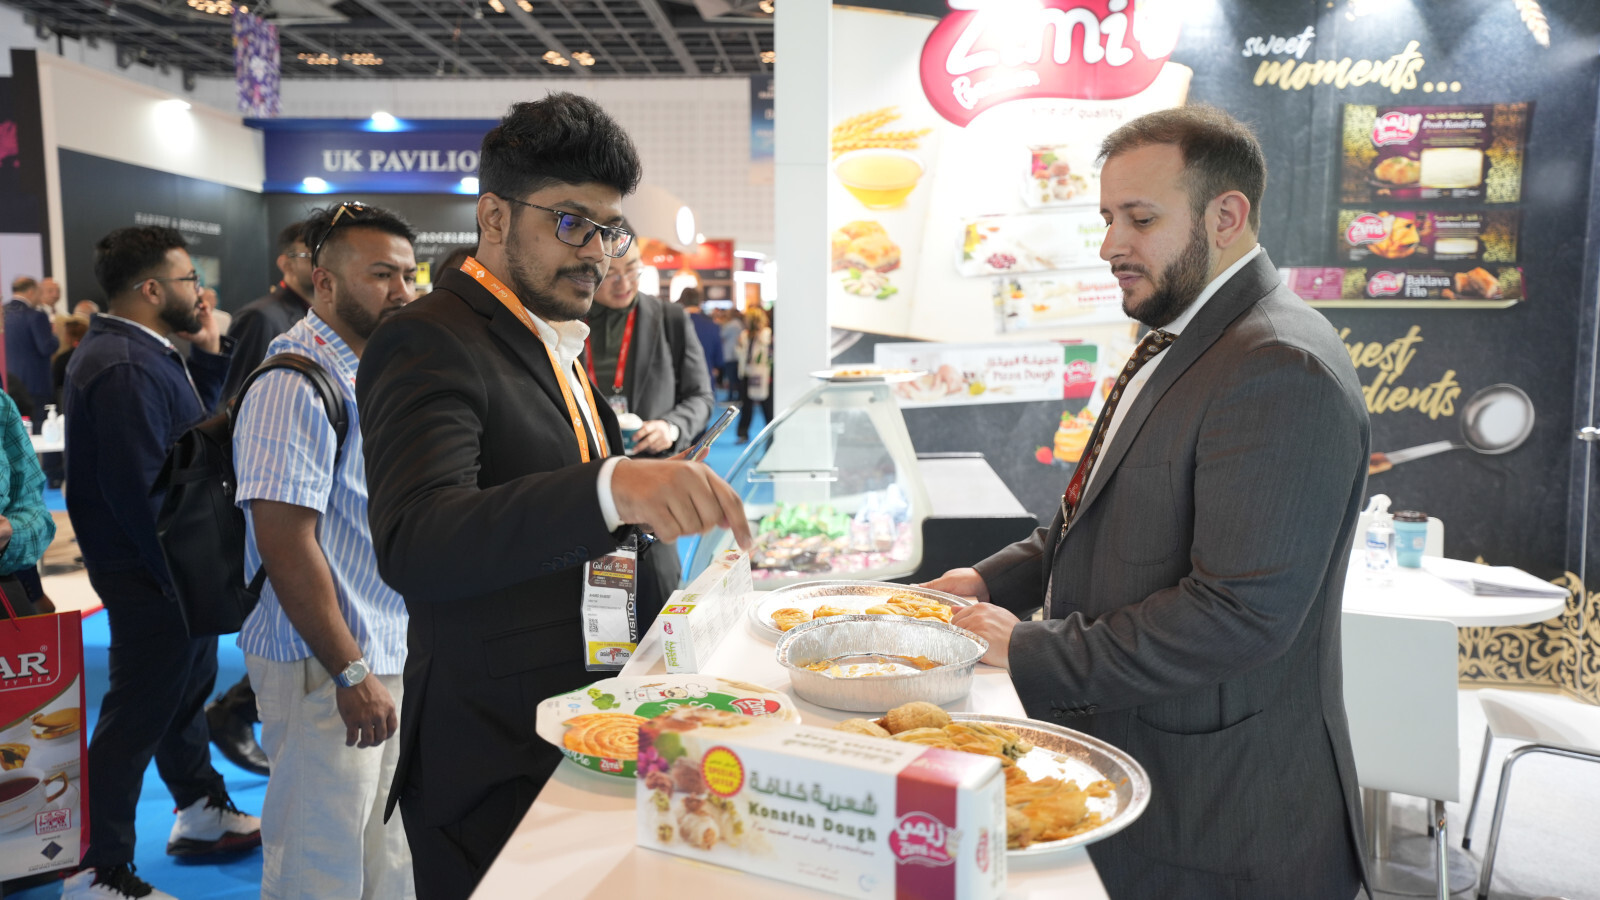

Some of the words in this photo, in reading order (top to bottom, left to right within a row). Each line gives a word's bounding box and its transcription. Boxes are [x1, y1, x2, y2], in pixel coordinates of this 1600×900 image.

[1242, 25, 1316, 60] sweet
[323, 150, 364, 172] UK
[369, 150, 481, 172] PAVILIO
[1405, 275, 1450, 287] Baklava
[1405, 286, 1427, 298] Filo
[1333, 325, 1424, 376] nest
[627, 593, 637, 641] VISITOR
[748, 801, 816, 829] Konafah
[823, 817, 877, 843] Dough
[898, 821, 945, 849] زيمي
